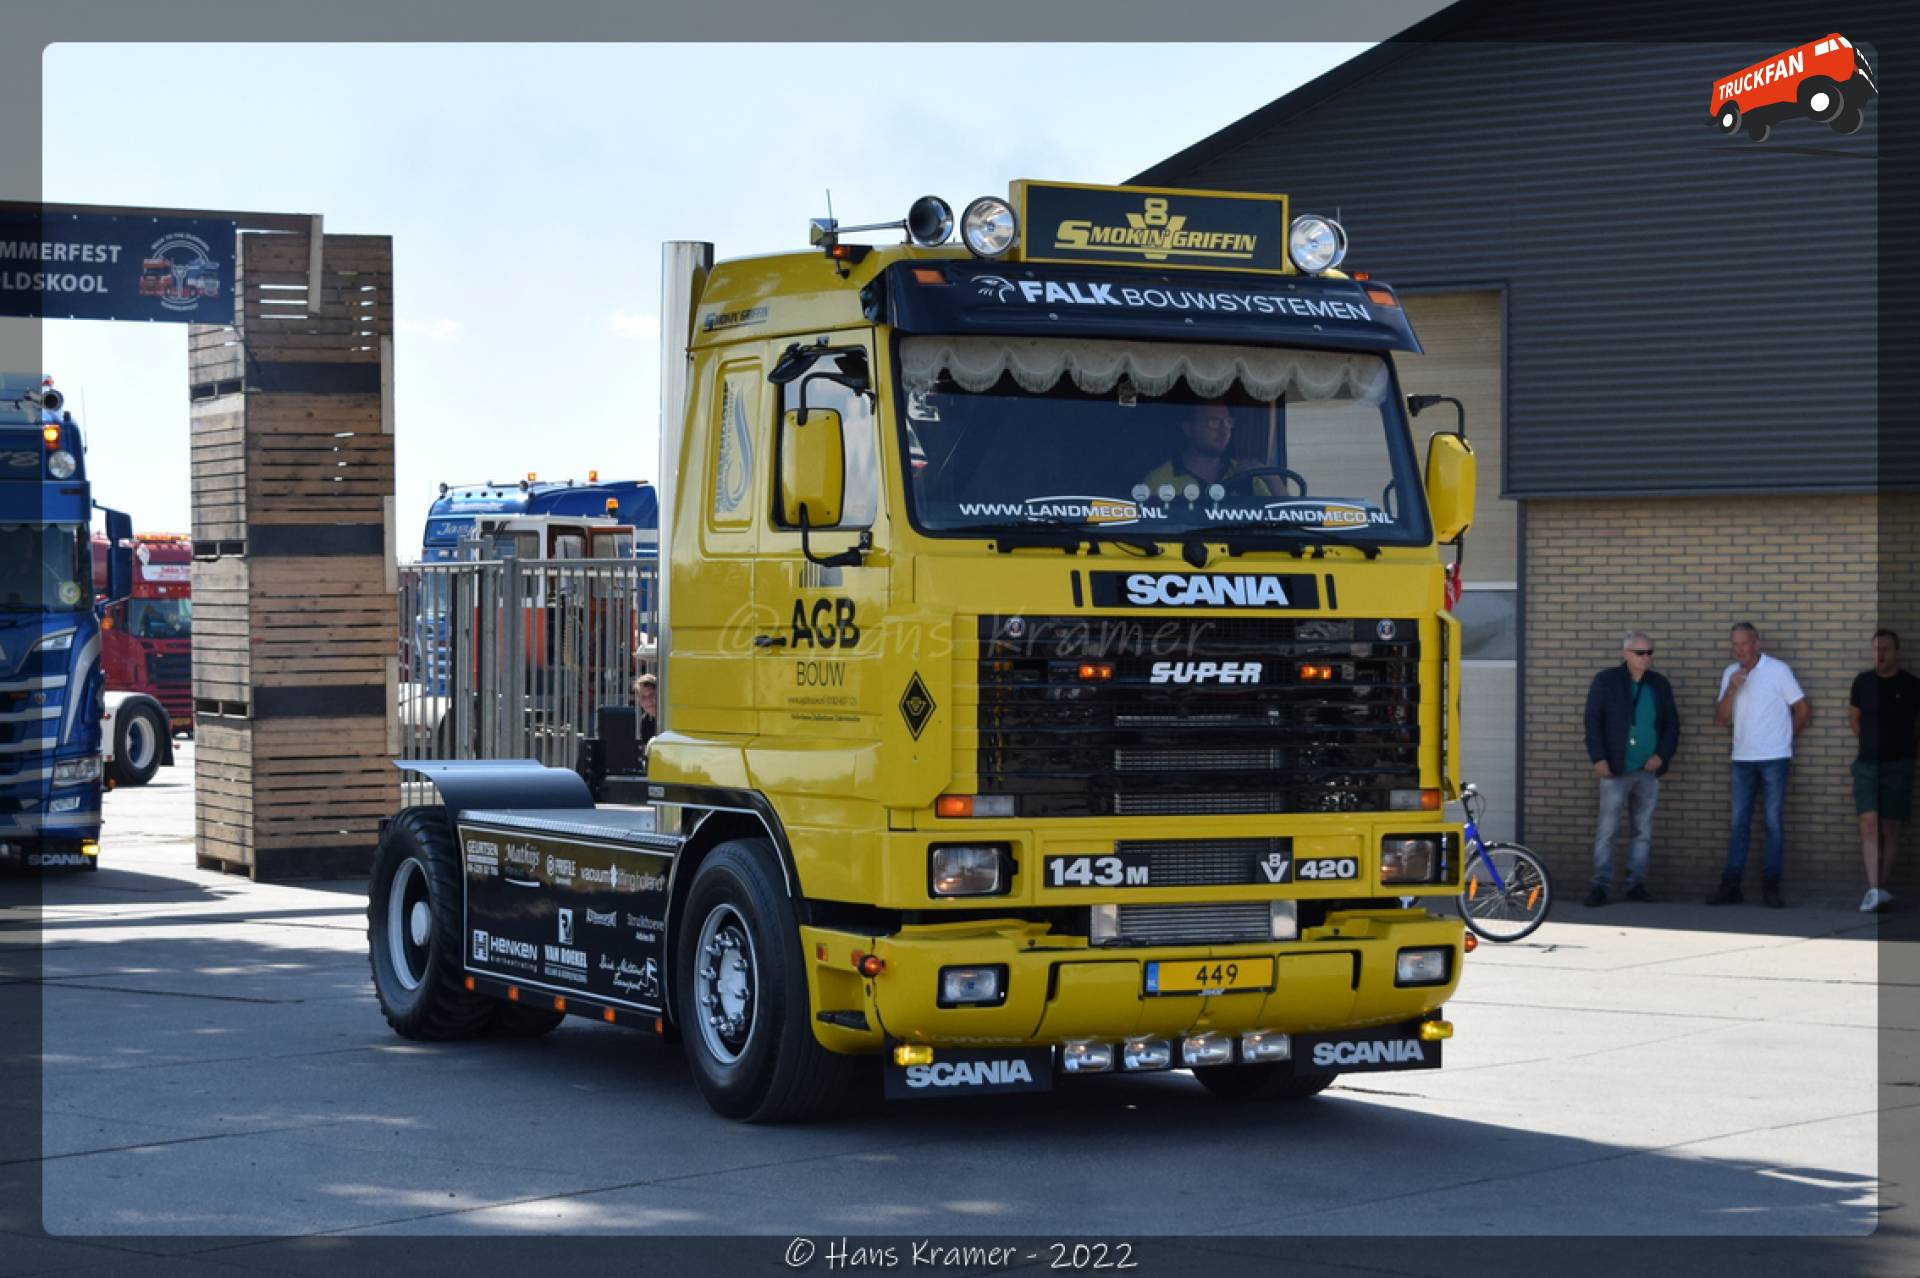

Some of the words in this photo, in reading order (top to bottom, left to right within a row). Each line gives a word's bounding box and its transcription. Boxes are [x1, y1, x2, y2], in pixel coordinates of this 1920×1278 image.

[1172, 230, 1257, 251] GRIFFIN
[1019, 280, 1124, 306] FALK
[1121, 289, 1372, 321] BOUWSYSTEMEN
[1126, 573, 1290, 606] SCANIA
[790, 596, 861, 649] AGB
[796, 661, 846, 687] BOUW
[1149, 661, 1263, 684] SUPER
[27, 853, 92, 866] SCANIA
[1300, 859, 1356, 879] 420
[490, 935, 538, 961] HENKEN
[1196, 963, 1239, 986] 449
[1312, 1039, 1425, 1066] SCANIA
[905, 1059, 1033, 1088] SCANIA
